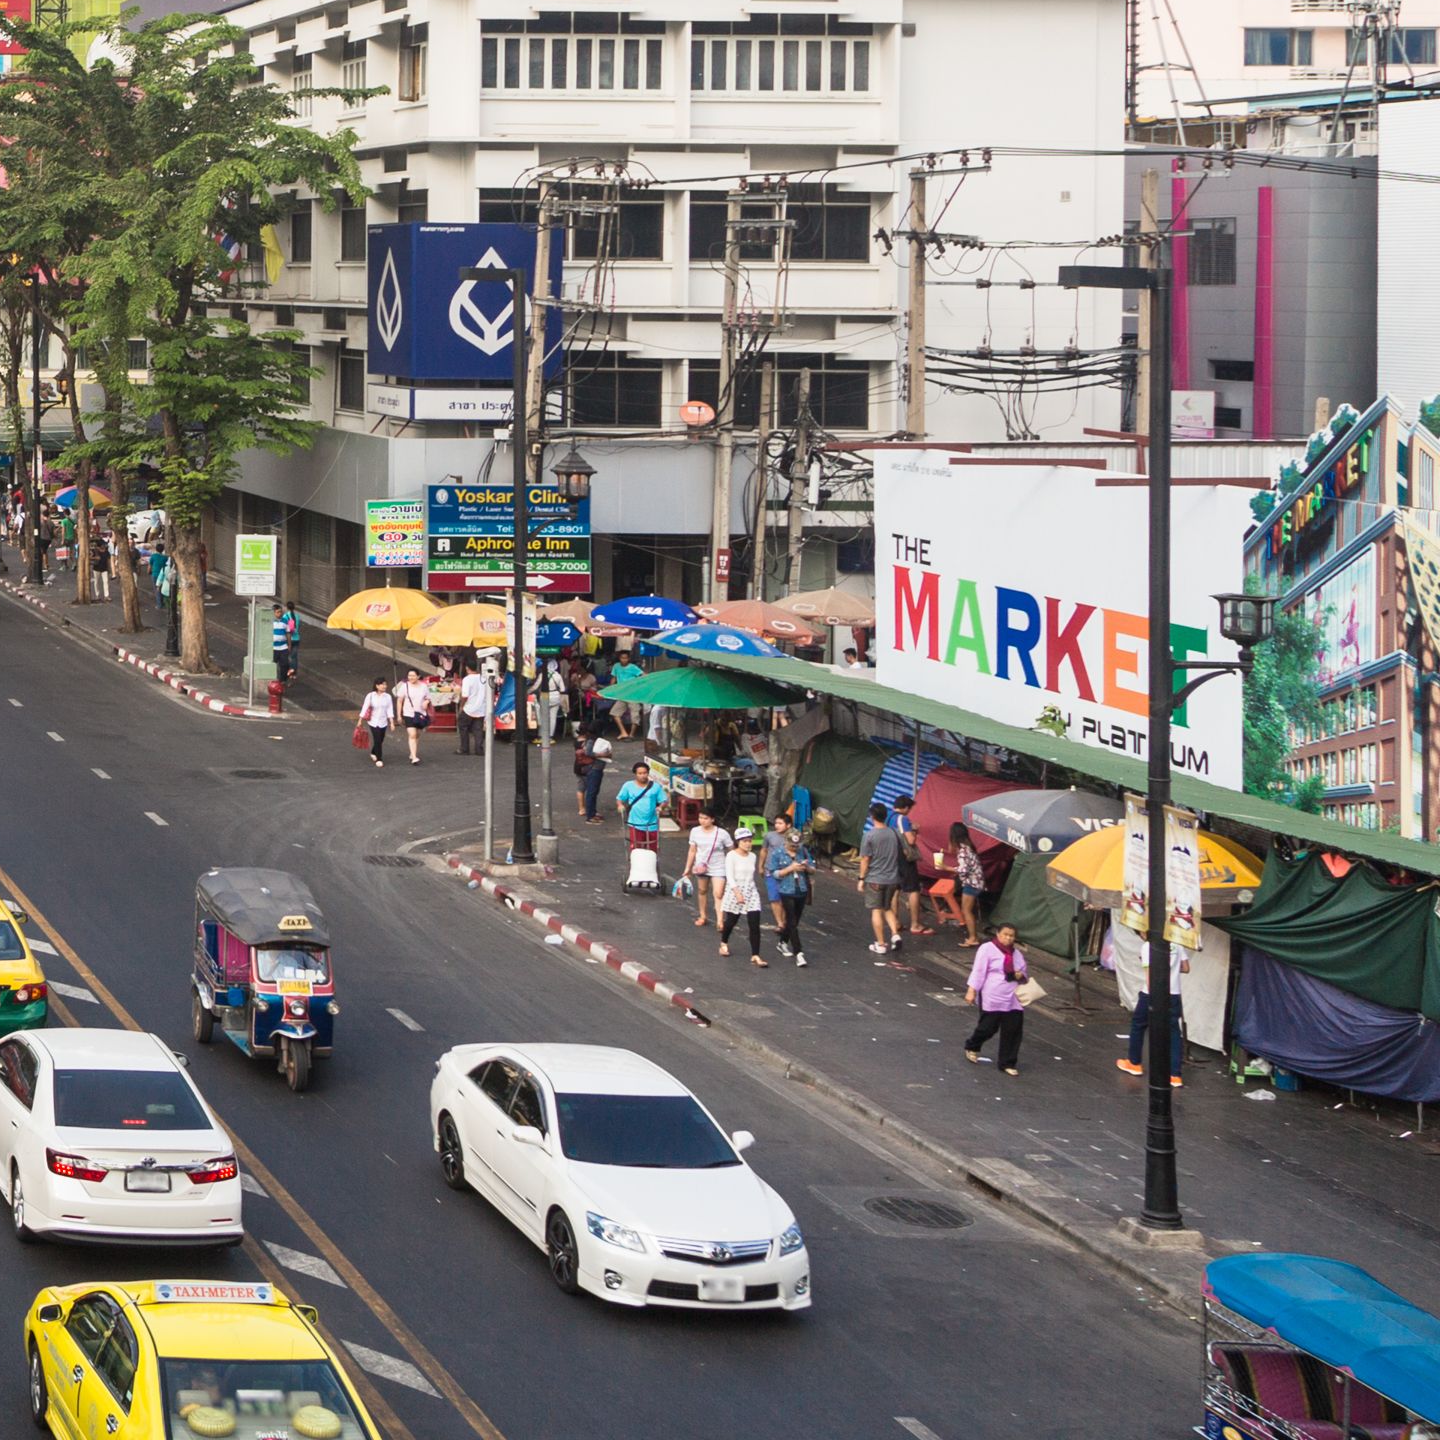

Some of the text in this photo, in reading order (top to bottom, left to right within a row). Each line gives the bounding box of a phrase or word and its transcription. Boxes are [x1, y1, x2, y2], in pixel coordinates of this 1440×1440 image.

[448, 401, 514, 414] สาขา ประตู
[1295, 429, 1373, 532] MARKET
[454, 489, 567, 503] Yoskar Clin
[496, 524, 514, 533] Tel:
[385, 533, 401, 541] 30
[465, 536, 570, 552] Aphrote Inn
[892, 533, 932, 567] THE
[498, 561, 588, 571] Tel 253-7000
[627, 606, 663, 616] VISA
[658, 619, 683, 629] VISA
[562, 627, 570, 639] 2
[891, 564, 1208, 729] MARKET
[1082, 716, 1209, 775] PLATUM
[1071, 816, 1125, 832] VISA
[1178, 818, 1194, 830] VISA
[1007, 827, 1026, 851] VISA
[283, 918, 307, 928] TAXI
[173, 1285, 256, 1298] TAXI-METER
